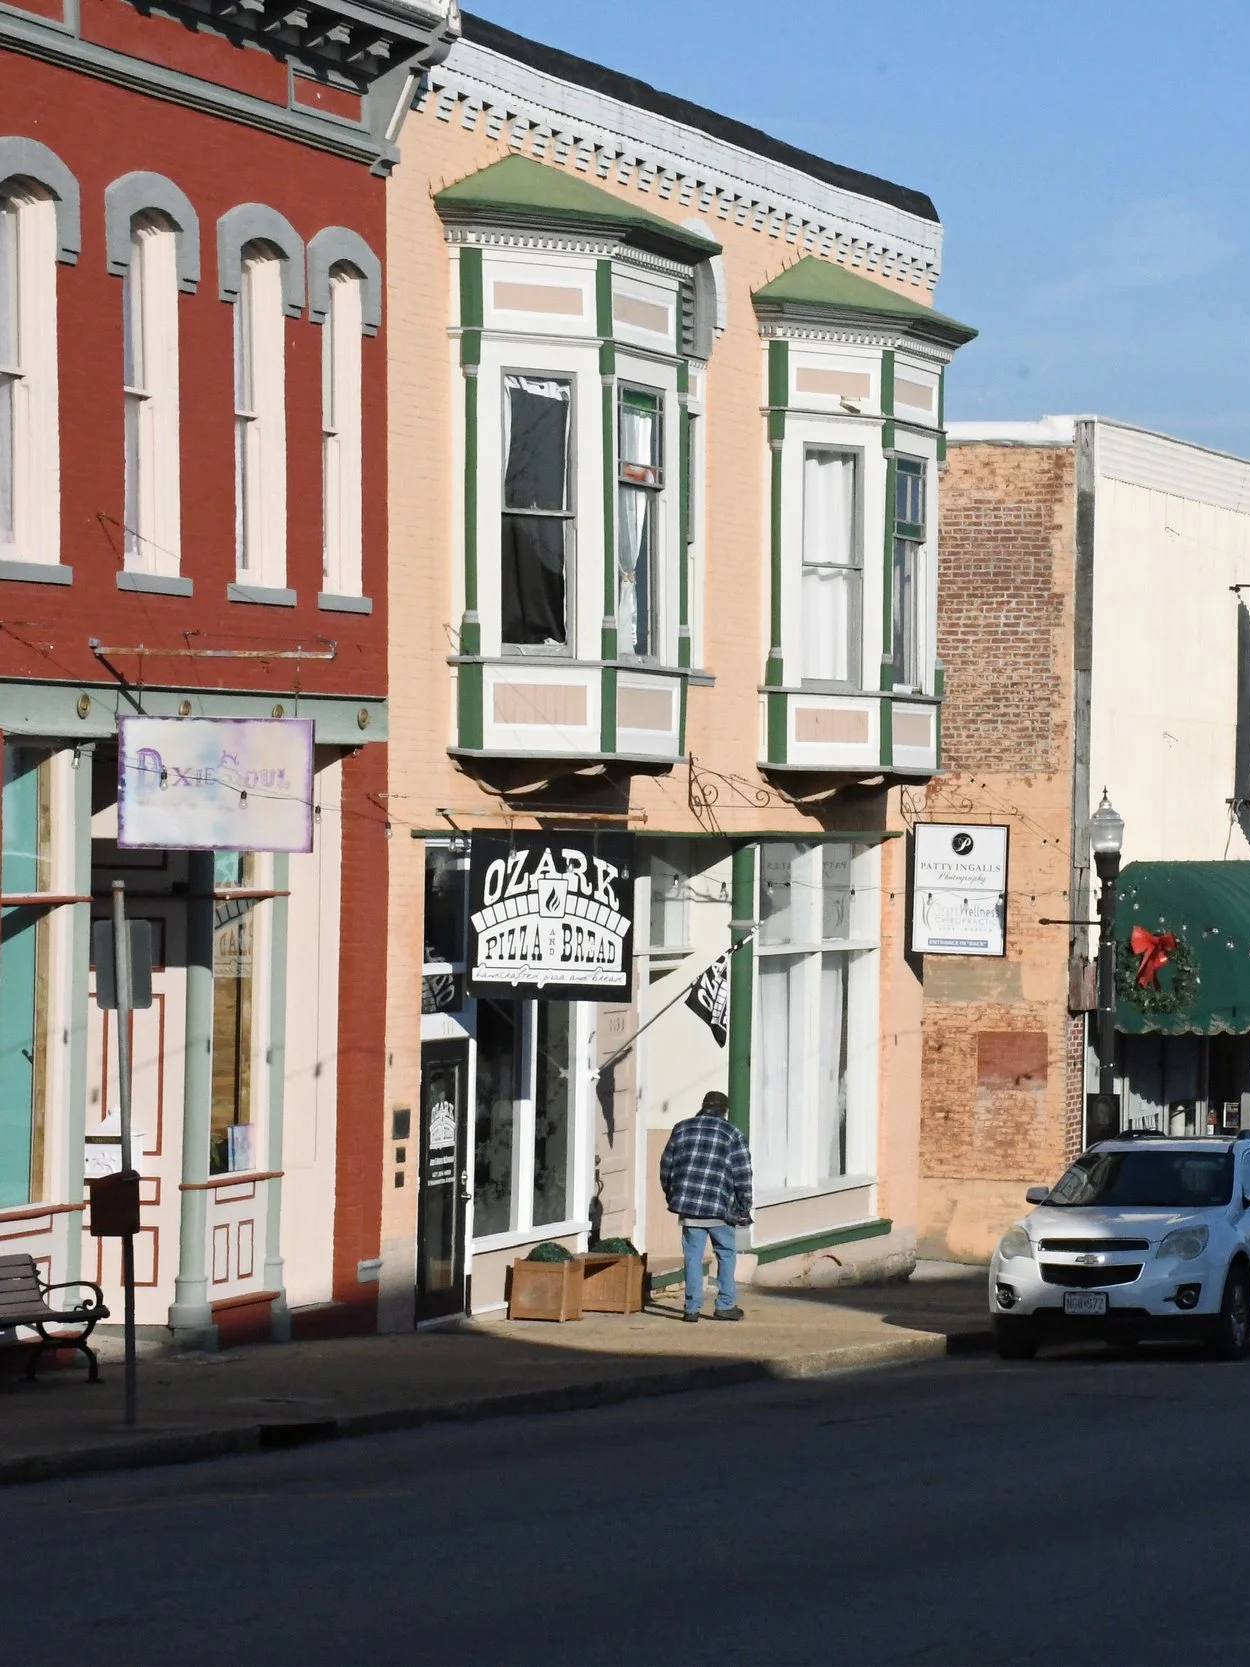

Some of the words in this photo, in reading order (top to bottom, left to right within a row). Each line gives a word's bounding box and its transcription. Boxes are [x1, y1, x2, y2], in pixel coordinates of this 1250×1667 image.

[136, 747, 216, 790] DXIE
[483, 847, 620, 912] OZARK
[920, 861, 953, 871] PATTY
[955, 862, 1001, 873] INGALLS
[485, 922, 543, 961] PIZZA
[548, 928, 556, 956] AND
[560, 922, 616, 964] BREAD
